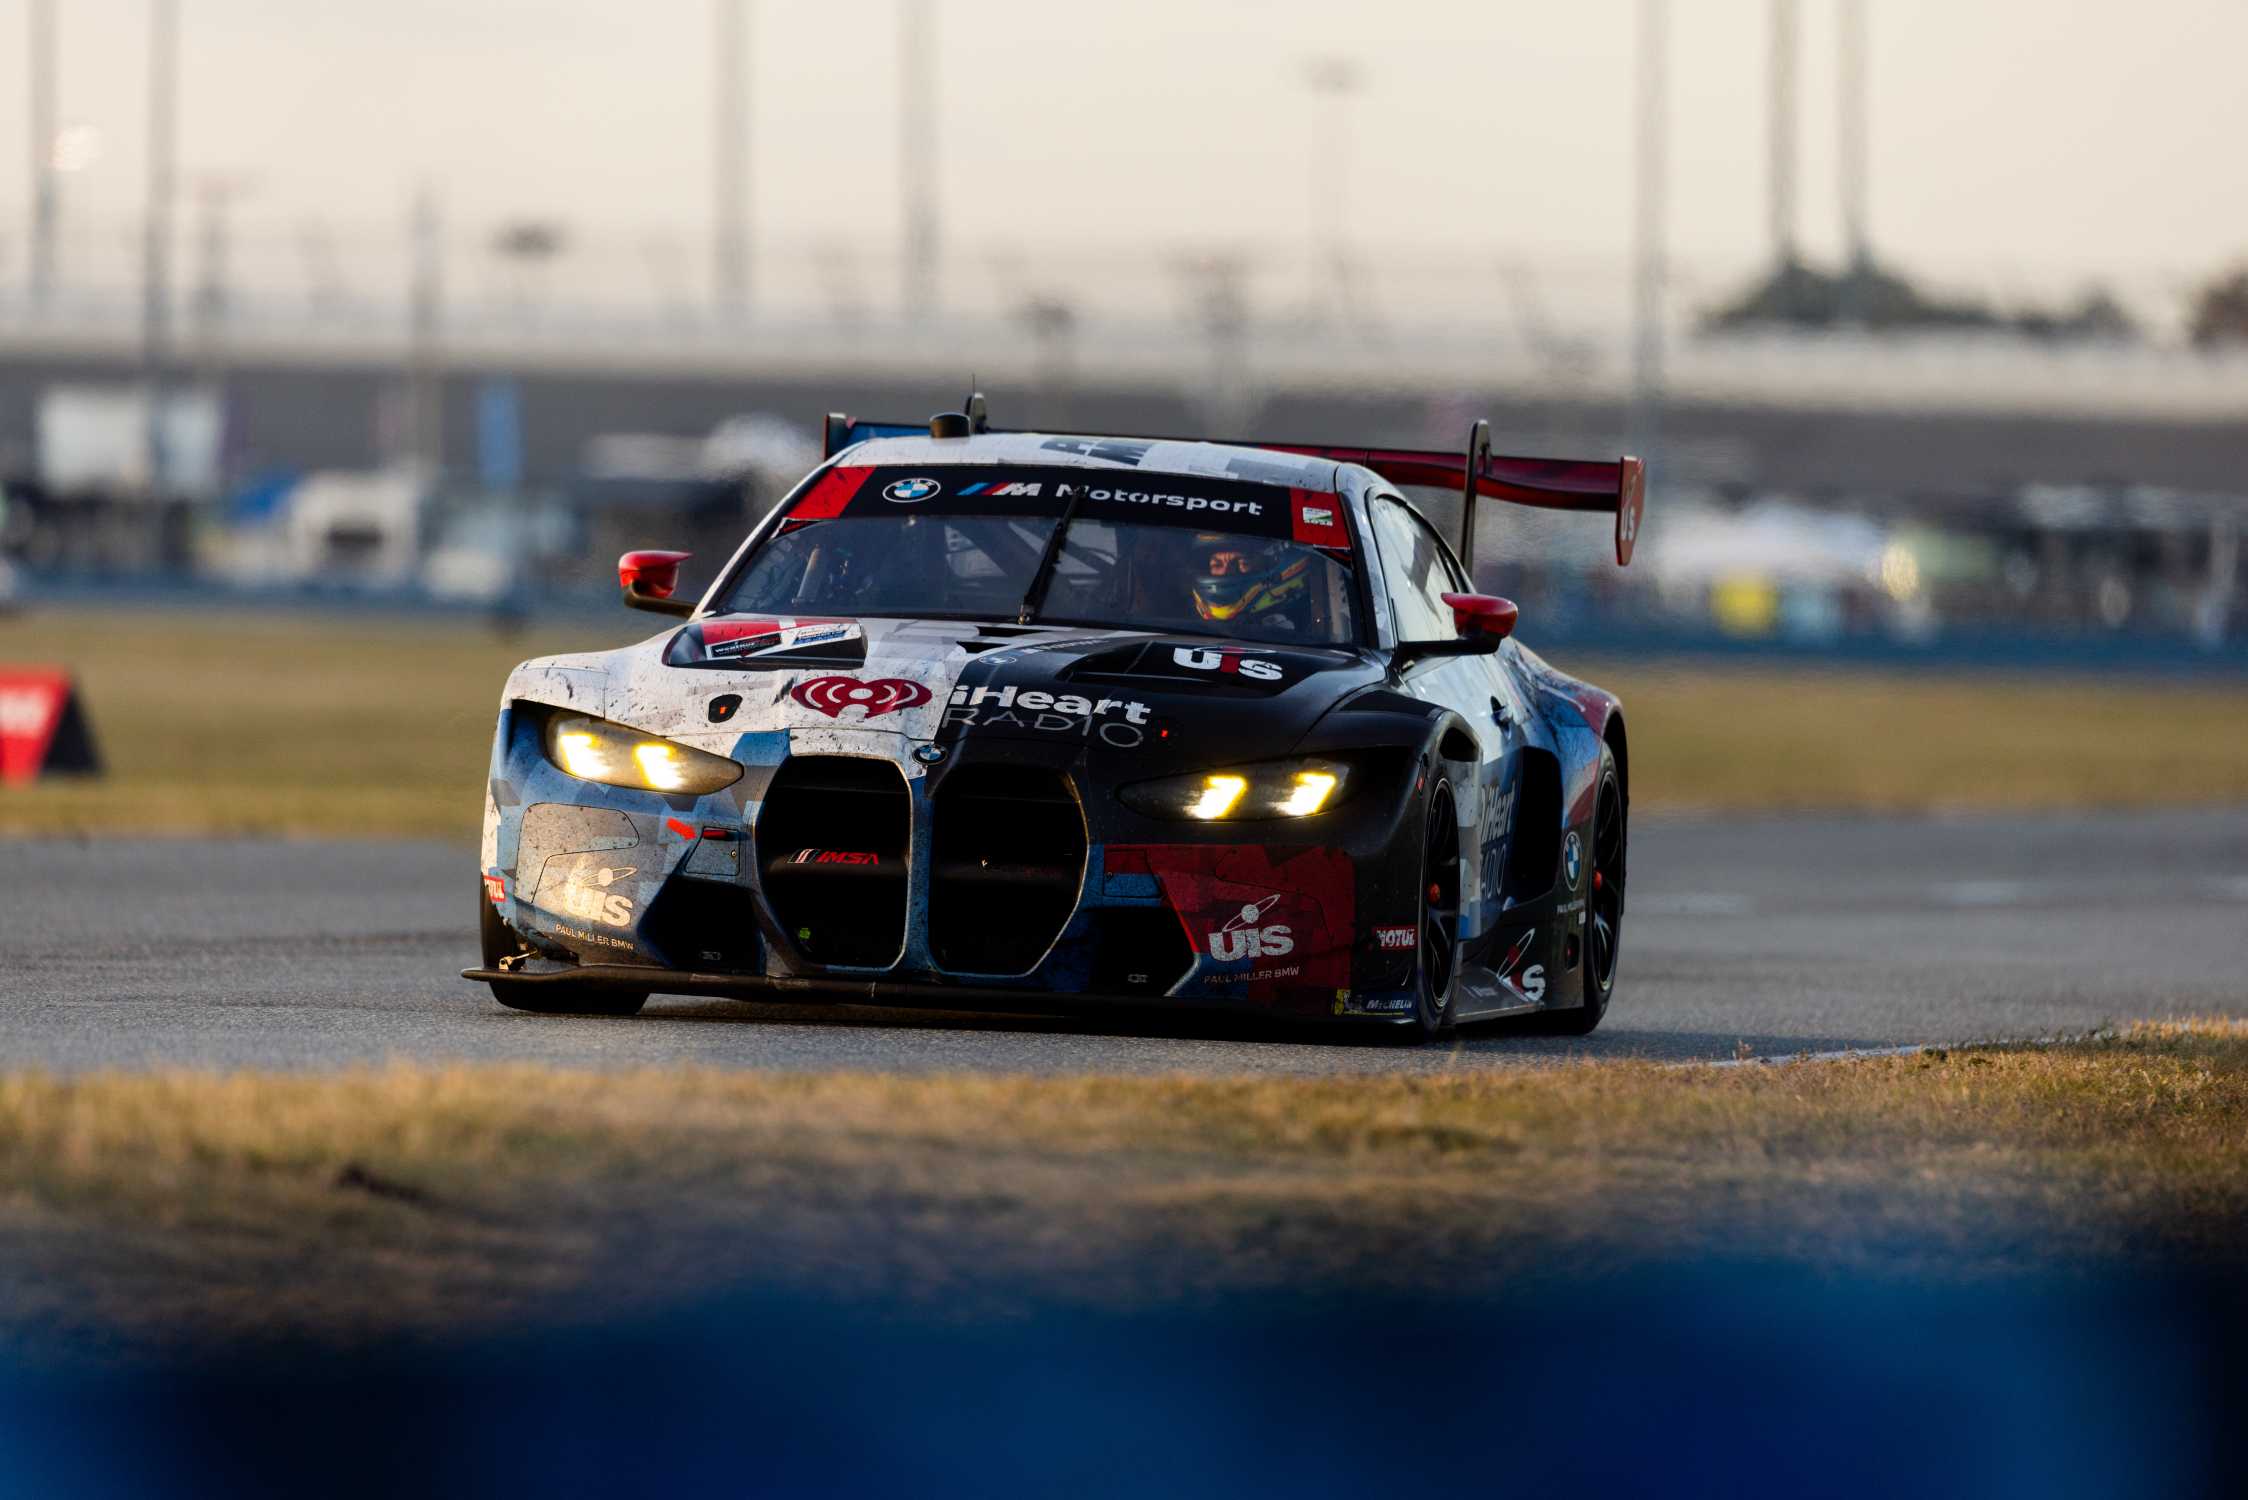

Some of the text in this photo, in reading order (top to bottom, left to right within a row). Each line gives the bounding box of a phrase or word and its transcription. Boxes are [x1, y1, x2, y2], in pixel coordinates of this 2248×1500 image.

[1056, 483, 1263, 515] Motorsport
[950, 685, 1151, 725] iHeart
[941, 707, 1144, 748] RADIO
[555, 923, 634, 951] PAUL MILLER BMW
[1376, 928, 1415, 948] MOTUL
[1233, 969, 1272, 982] MILLER
[1274, 965, 1300, 978] BMW
